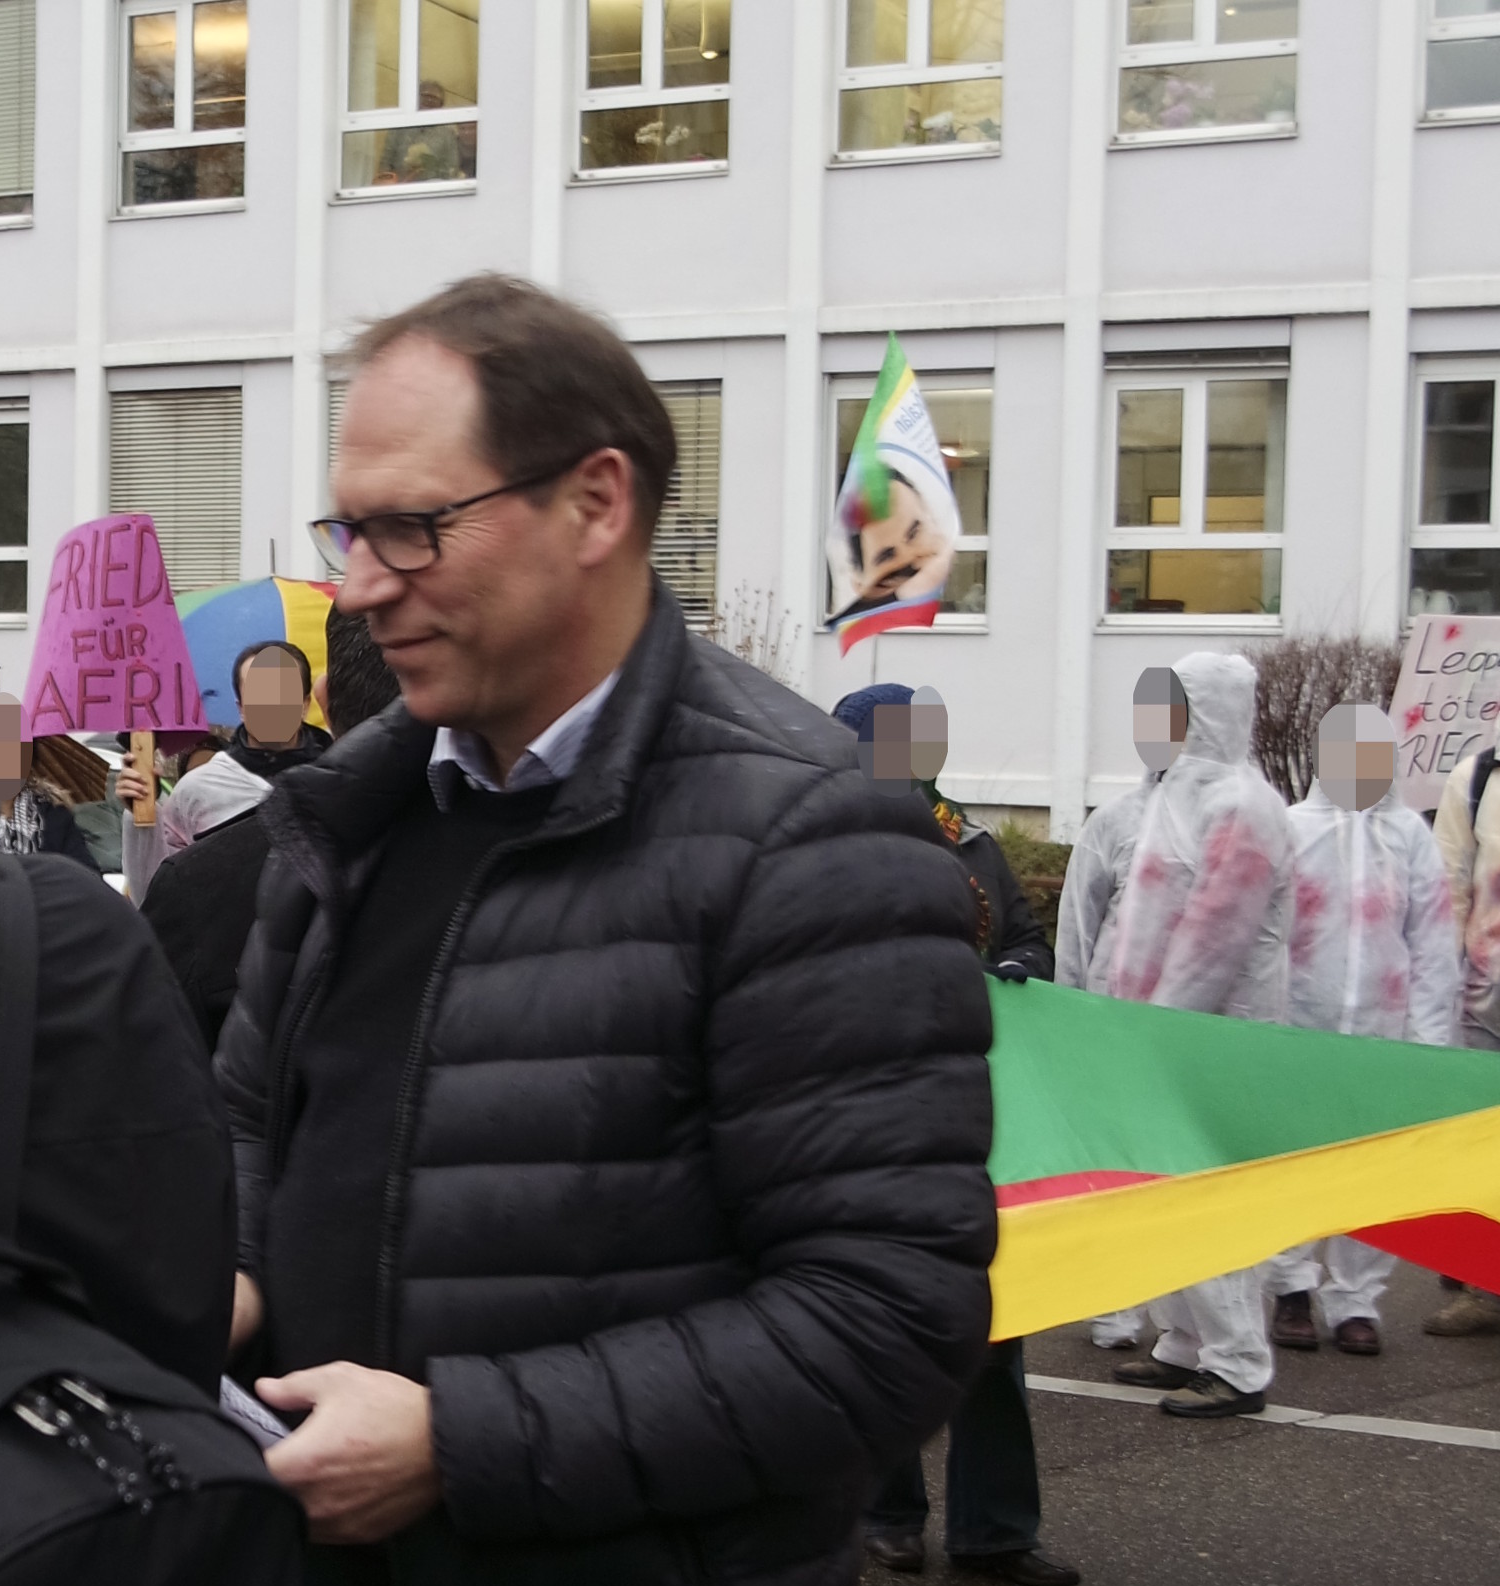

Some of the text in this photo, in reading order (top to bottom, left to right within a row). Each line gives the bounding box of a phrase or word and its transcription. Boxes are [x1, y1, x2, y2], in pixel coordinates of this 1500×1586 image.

[69, 617, 148, 663] FÜR
[1414, 622, 1500, 681] Leop
[31, 661, 203, 731] AFRI
